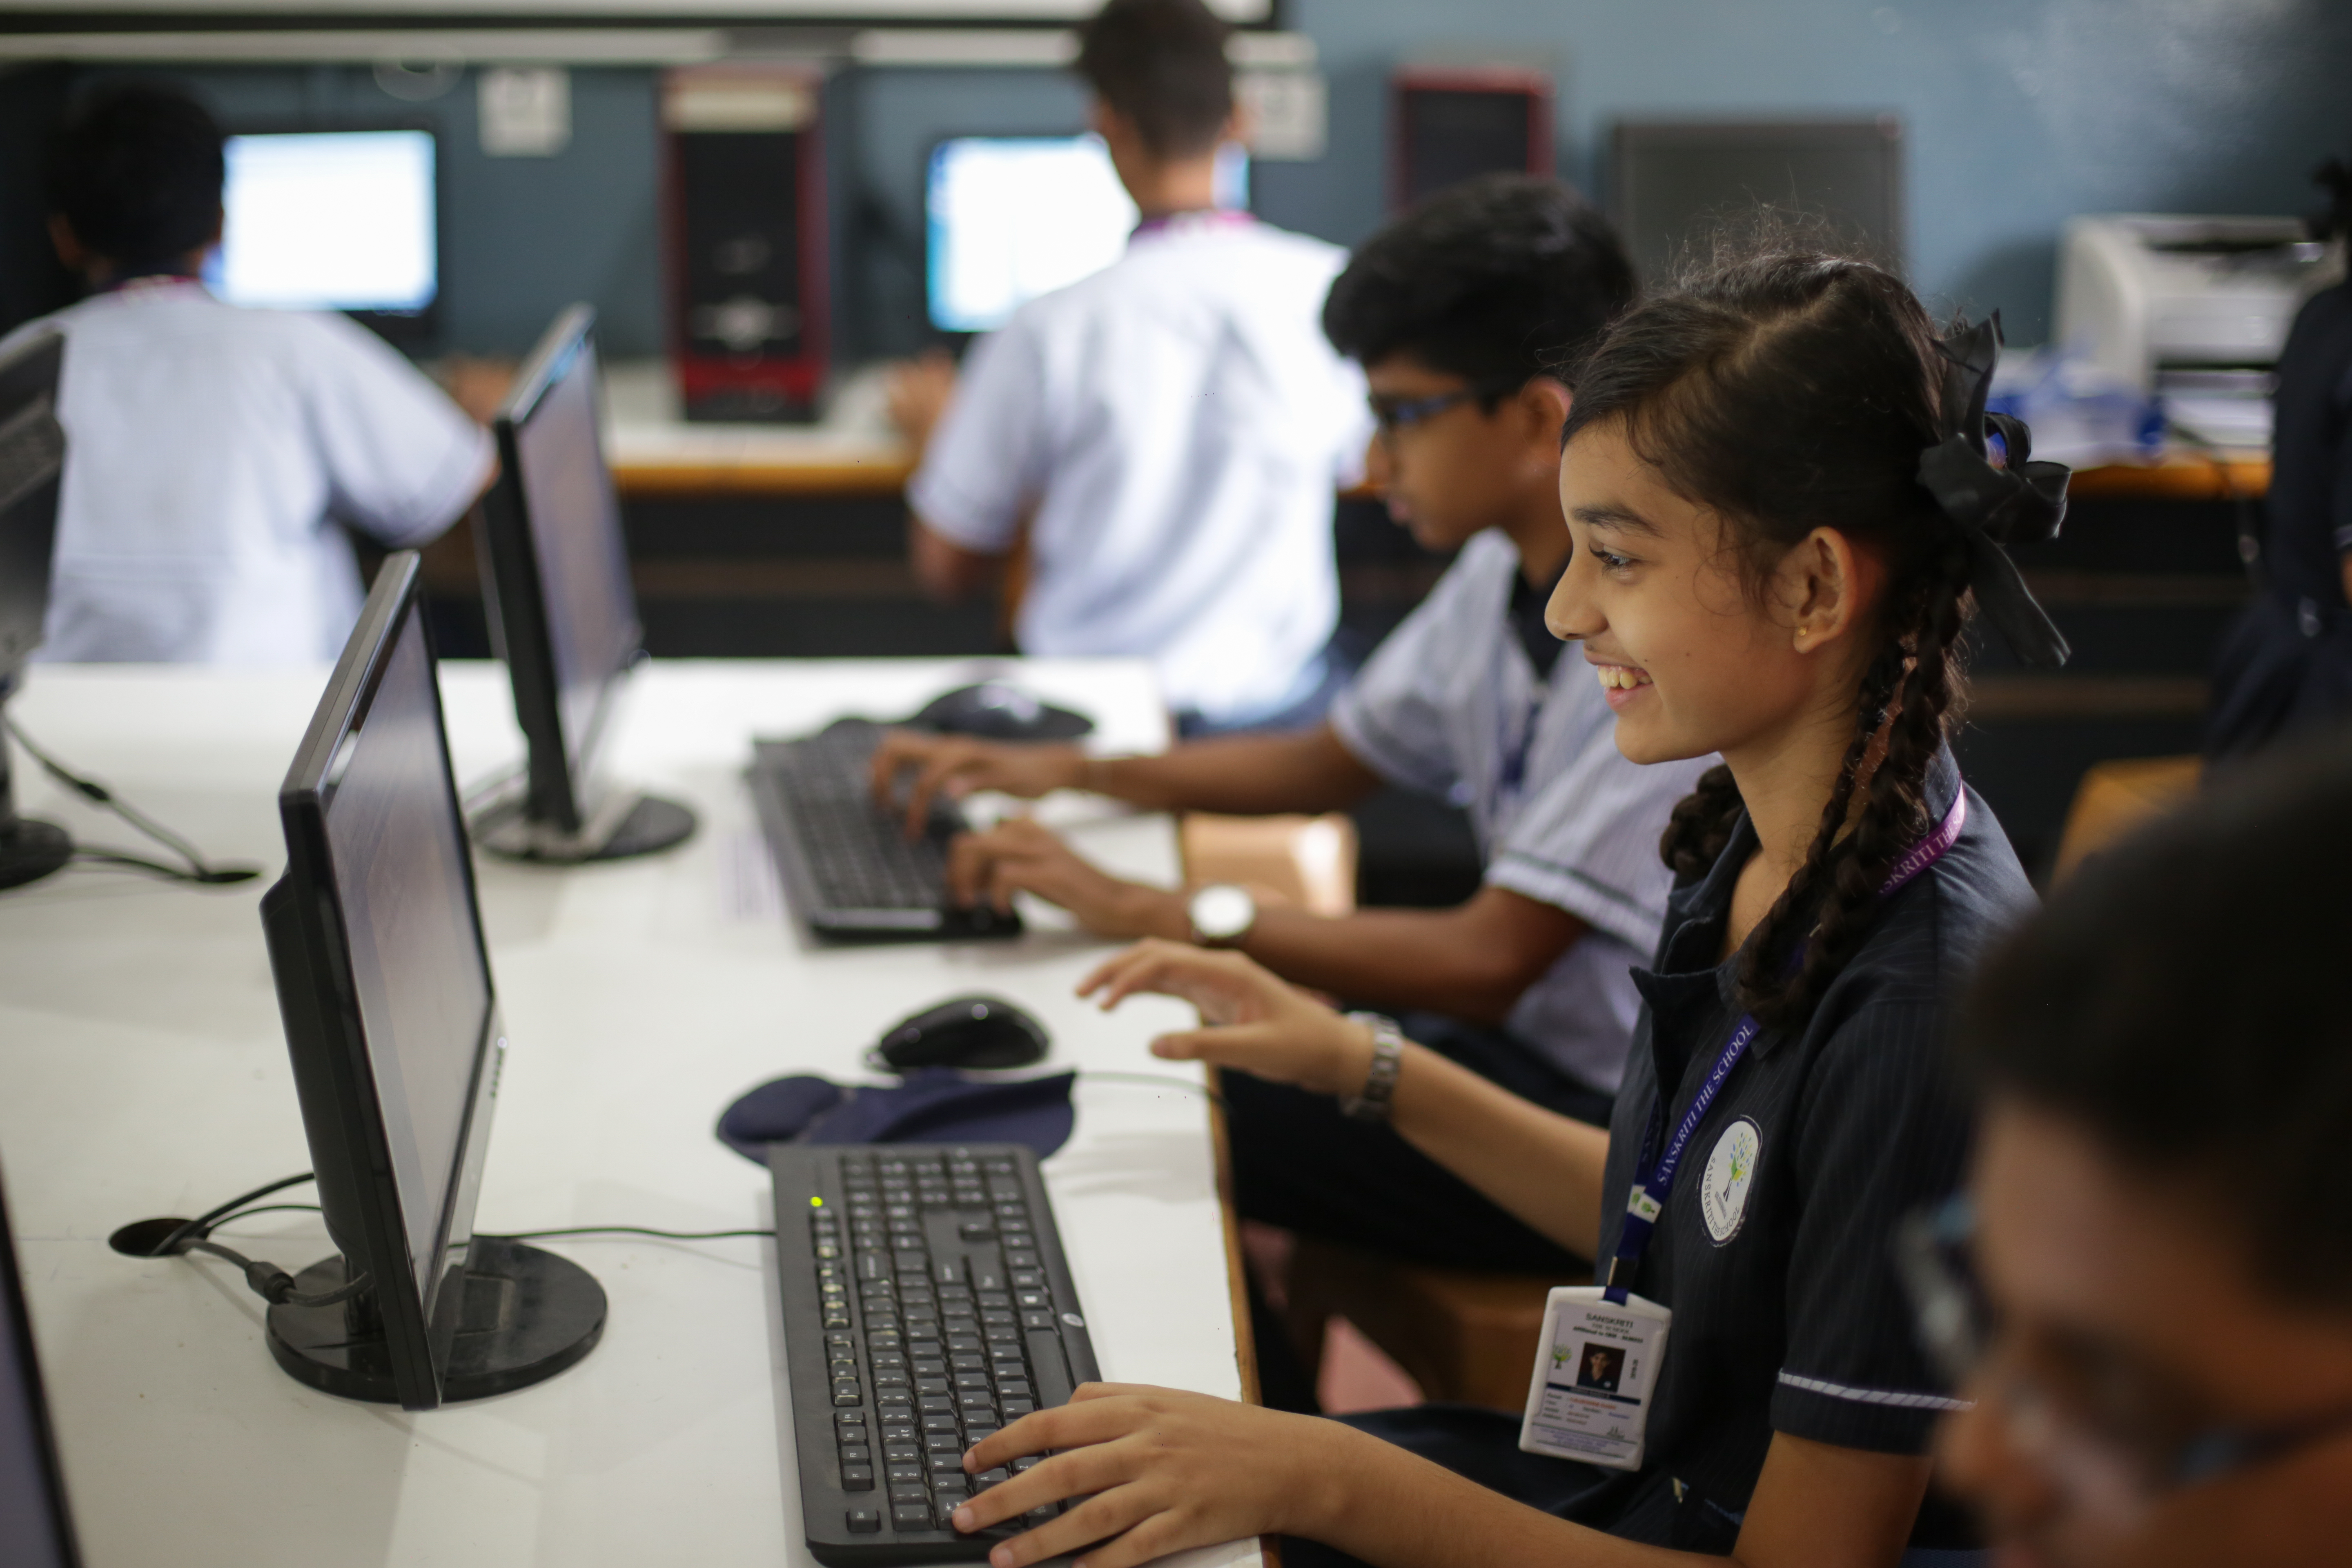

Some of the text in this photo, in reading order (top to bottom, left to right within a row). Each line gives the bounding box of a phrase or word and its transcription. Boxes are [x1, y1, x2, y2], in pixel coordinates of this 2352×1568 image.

[1933, 822, 1955, 849] THE
[1657, 1025, 1753, 1186] SANSKRITI THE SCHOOL
[1704, 1156, 1715, 1224] SANSKRITI
[1719, 1207, 1740, 1236] SCHOOL
